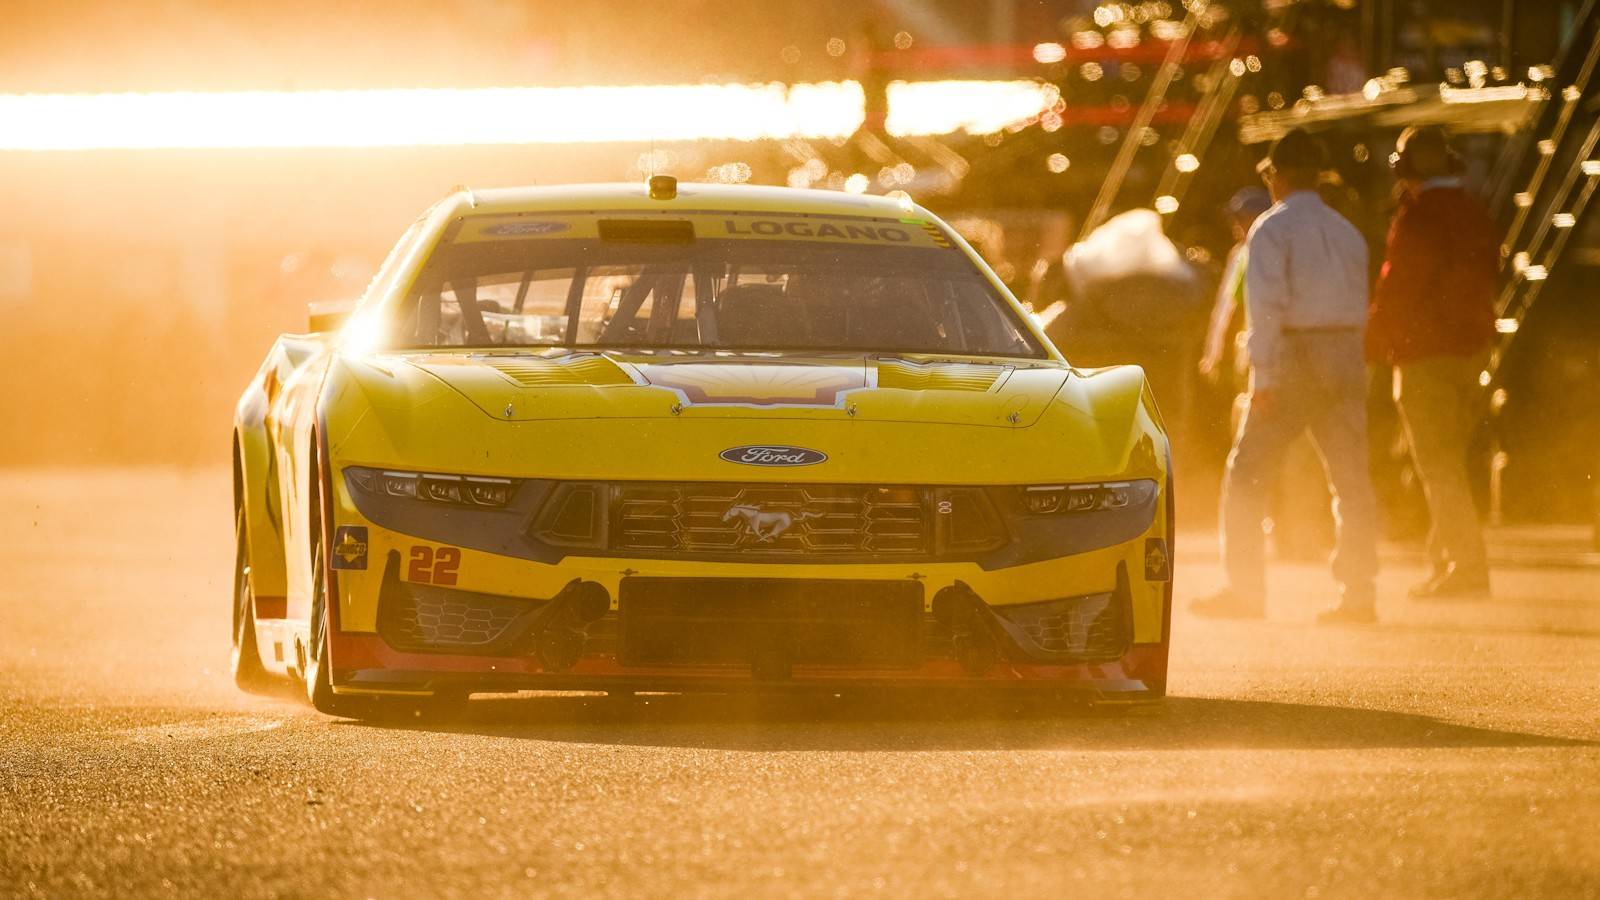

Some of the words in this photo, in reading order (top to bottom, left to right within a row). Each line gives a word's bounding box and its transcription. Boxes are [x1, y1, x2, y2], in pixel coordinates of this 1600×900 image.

[725, 220, 911, 242] LOGANO
[741, 447, 805, 463] Ford
[408, 545, 461, 586] 22
